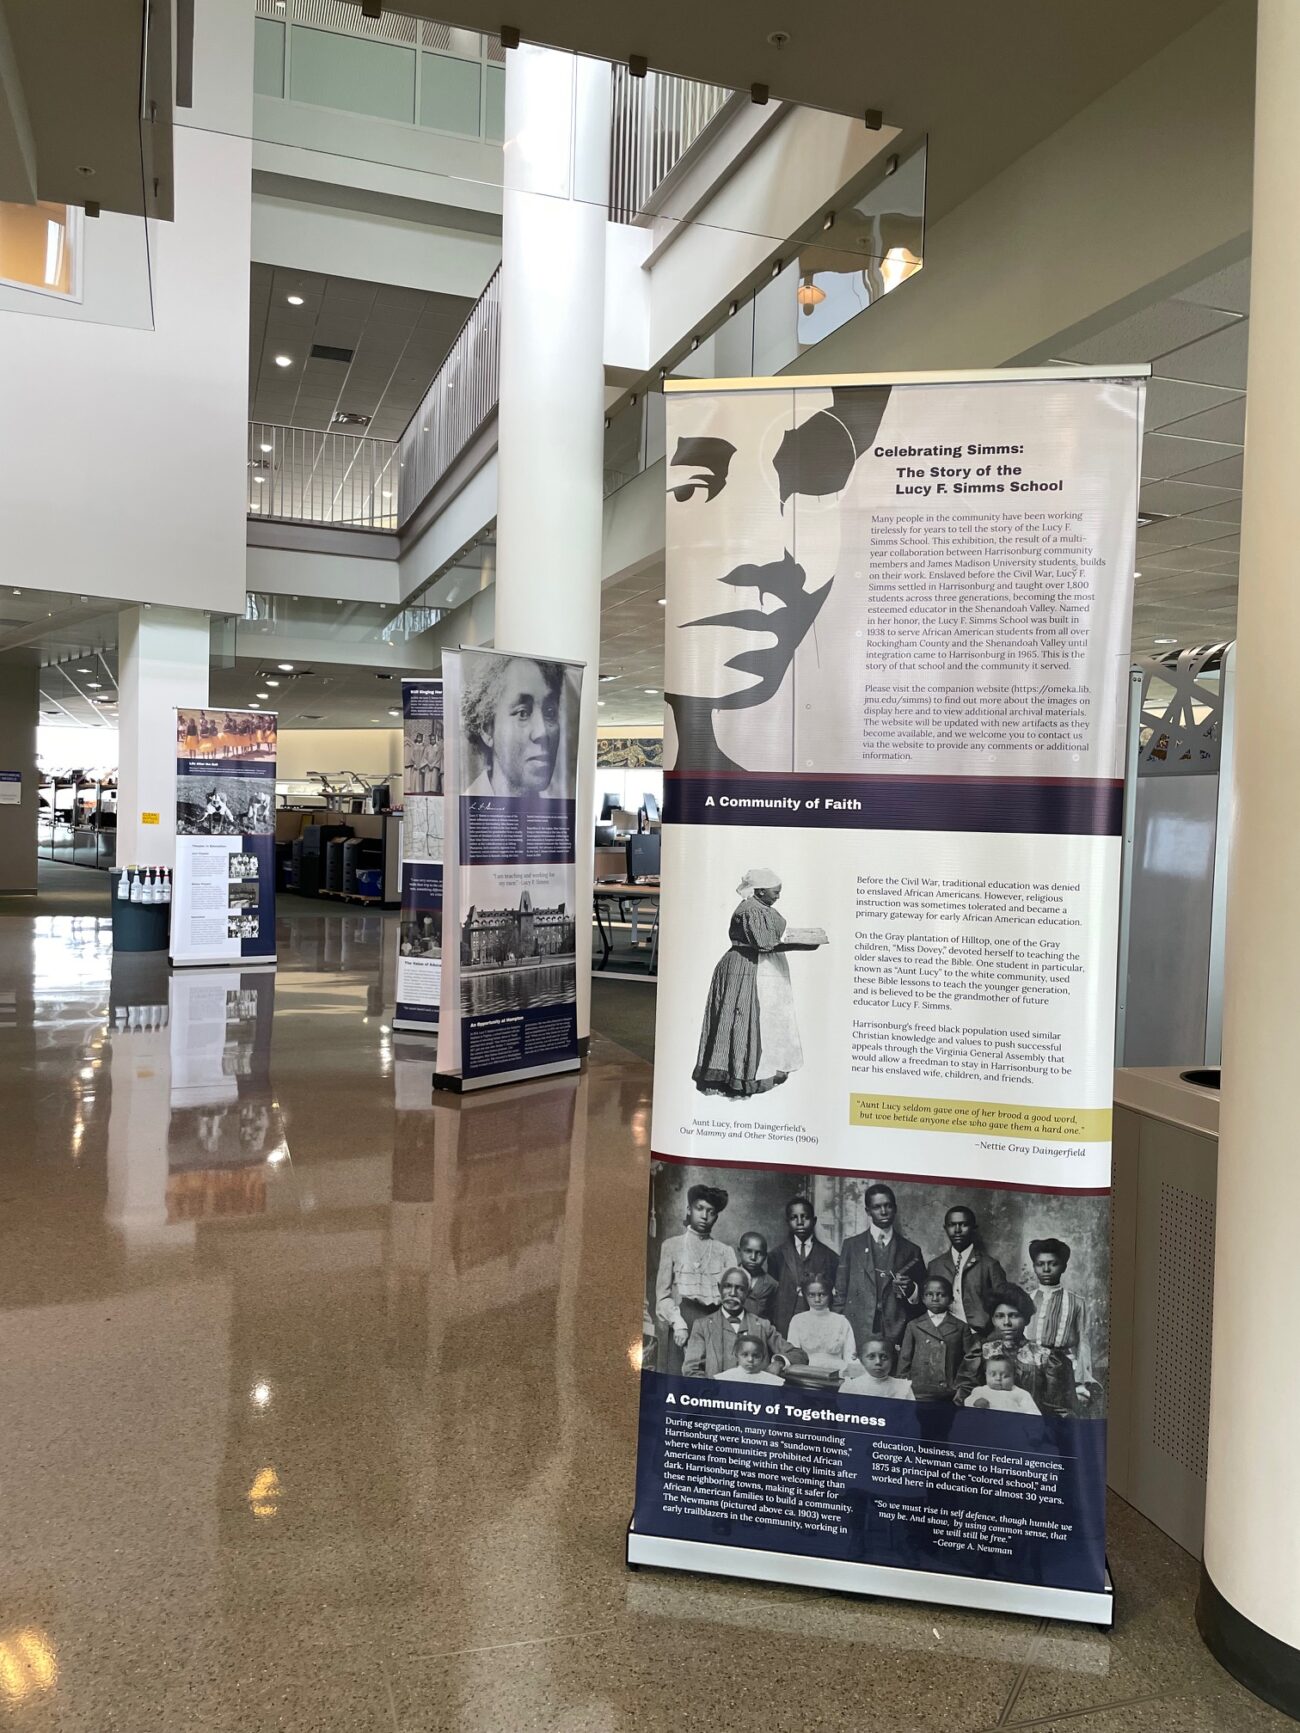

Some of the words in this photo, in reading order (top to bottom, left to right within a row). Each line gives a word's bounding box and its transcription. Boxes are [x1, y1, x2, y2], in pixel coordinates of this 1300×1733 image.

[874, 444, 962, 458] Celebrating
[967, 443, 1023, 455] Simms:
[895, 466, 924, 477] The
[929, 466, 971, 479] Story
[975, 464, 991, 476] of
[996, 464, 1021, 475] the
[895, 484, 931, 496] Lucy
[936, 483, 947, 493] F.
[953, 482, 1004, 493] Simms
[1009, 479, 1062, 492] School
[871, 515, 894, 525] Many
[895, 514, 924, 524] people
[926, 514, 934, 522] in
[936, 513, 949, 521] the
[951, 513, 1000, 523] community
[1002, 512, 1022, 520] have
[1024, 511, 1045, 520] been
[1047, 511, 1083, 521] working
[864, 684, 890, 692] Please
[892, 684, 909, 692] visit
[911, 684, 925, 692] the
[927, 684, 974, 694] companion
[976, 684, 1009, 692] website
[705, 796, 715, 806] A
[719, 796, 801, 811] Community
[805, 797, 819, 808] of
[824, 798, 861, 809] Faith
[504, 872, 523, 880] teaching
[532, 872, 548, 880] working
[856, 875, 883, 884] Before
[885, 876, 899, 884] the
[900, 877, 919, 885] Civil
[921, 878, 940, 887] War,
[942, 879, 985, 887] traditional
[987, 880, 1030, 889] education
[1050, 882, 1080, 891] denied
[477, 1019, 500, 1027] Opportunity
[914, 1022, 936, 1032] freed
[938, 1024, 960, 1033] black
[962, 1026, 1007, 1036] population
[1009, 1029, 1029, 1038] used
[1032, 1031, 1061, 1039] similar
[881, 1101, 900, 1112] Lucy
[902, 1103, 931, 1112] seldom
[933, 1107, 952, 1115] gave
[971, 1108, 980, 1118] of
[981, 1108, 996, 1117] her
[997, 1109, 1021, 1119] brood
[1031, 1114, 1051, 1123] good
[1054, 1115, 1077, 1124] word,
[692, 1118, 709, 1126] Aunt
[711, 1119, 731, 1129] Lucy,
[733, 1120, 752, 1129] from
[859, 1110, 872, 1119] but
[893, 1113, 917, 1122] betide
[919, 1117, 949, 1125] anyone
[951, 1117, 967, 1125] else
[969, 1119, 987, 1127] who
[988, 1122, 1008, 1130] gave
[1010, 1122, 1031, 1131] them
[1041, 1124, 1061, 1133] hard
[679, 1126, 694, 1134] Our
[696, 1128, 726, 1139] Mammy
[727, 1130, 742, 1138] and
[743, 1131, 766, 1139] Other
[767, 1132, 794, 1141] Stories
[795, 1134, 818, 1145] (1906)
[1007, 1143, 1030, 1155] Gray
[1032, 1145, 1085, 1158] Daingerfield
[665, 1392, 676, 1404] A
[680, 1394, 761, 1415] Community
[765, 1403, 780, 1414] of
[784, 1405, 885, 1426] Togetherness
[665, 1416, 693, 1429] During
[694, 1421, 742, 1433] segregation,
[744, 1427, 766, 1437] many
[768, 1428, 793, 1438] towns
[794, 1432, 845, 1446] surrounding
[665, 1427, 718, 1443] Harrisonburg
[719, 1435, 739, 1443] were
[741, 1435, 768, 1446] known
[872, 1440, 916, 1453] education,
[918, 1444, 956, 1458] business,
[958, 1451, 974, 1459] and
[976, 1451, 989, 1460] for
[991, 1453, 1022, 1465] Federal
[1024, 1459, 1064, 1470] agencies.
[662, 1492, 678, 1501] The
[680, 1494, 719, 1506] Newmans
[720, 1499, 757, 1511] (pictured
[758, 1504, 782, 1514] above
[798, 1509, 819, 1520] 1903)
[820, 1513, 841, 1521] were
[901, 1504, 921, 1512] must
[923, 1505, 938, 1514] rise
[940, 1507, 948, 1515] in
[950, 1509, 964, 1519] self
[965, 1510, 997, 1522] defence,
[999, 1514, 1027, 1526] though
[1028, 1518, 1058, 1529] humble
[878, 1511, 895, 1521] may
[896, 1511, 907, 1520] be.
[909, 1514, 925, 1522] And
[927, 1516, 949, 1526] show,
[953, 1519, 963, 1529] by
[964, 1521, 986, 1532] using
[988, 1525, 1022, 1535] common
[1024, 1529, 1048, 1539] sense,
[1050, 1531, 1067, 1540] that
[946, 1529, 961, 1537] will
[962, 1531, 977, 1539] still
[979, 1531, 988, 1540] be
[966, 1542, 974, 1550] A.
[976, 1543, 1012, 1555] Newman
